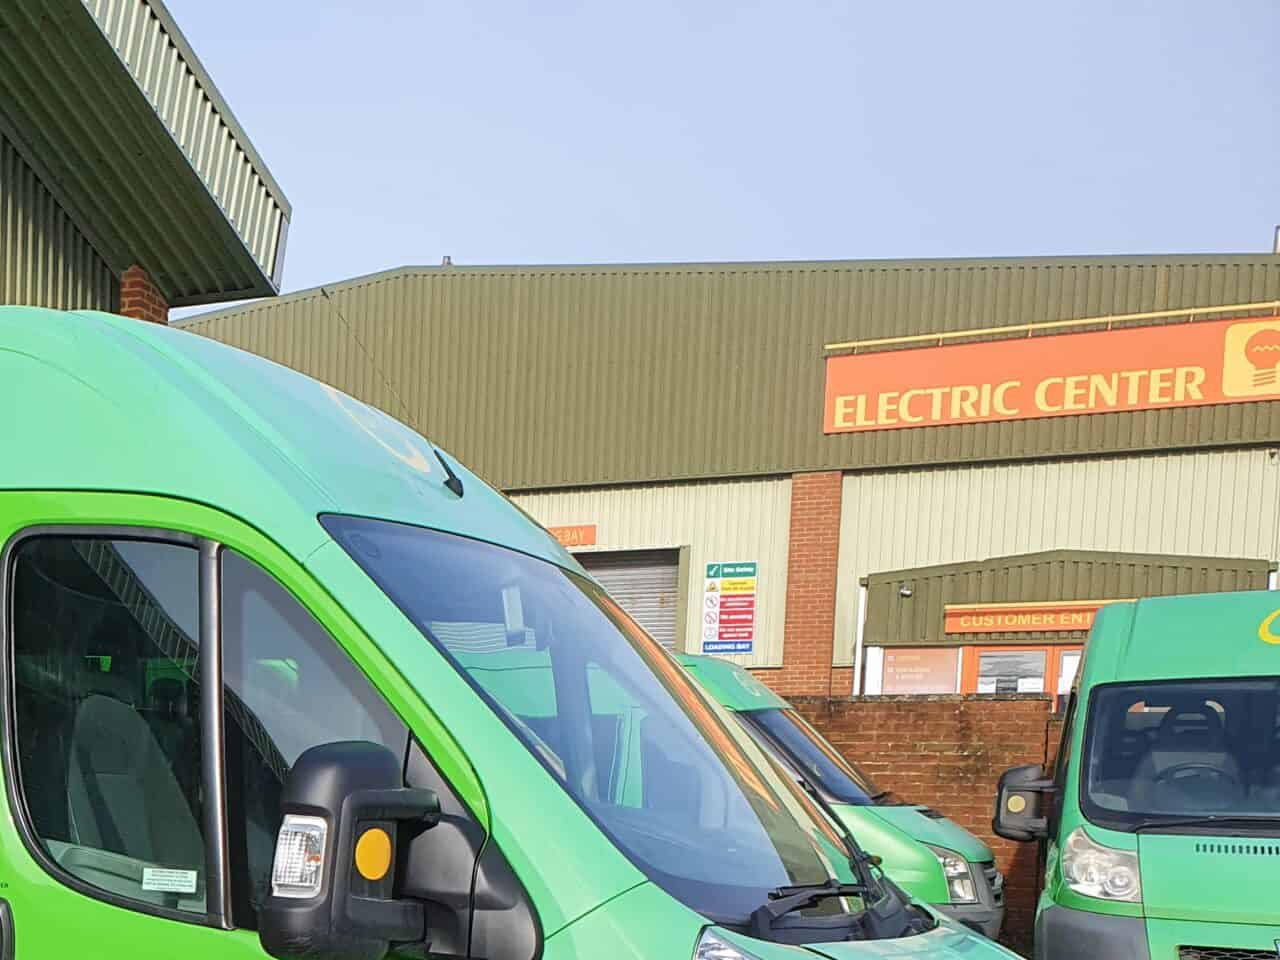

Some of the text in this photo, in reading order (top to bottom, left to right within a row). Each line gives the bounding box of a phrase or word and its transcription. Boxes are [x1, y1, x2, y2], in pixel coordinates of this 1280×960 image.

[833, 366, 1207, 428] ELECTRIC CENTER
[960, 613, 1054, 628] CUSTOMER
